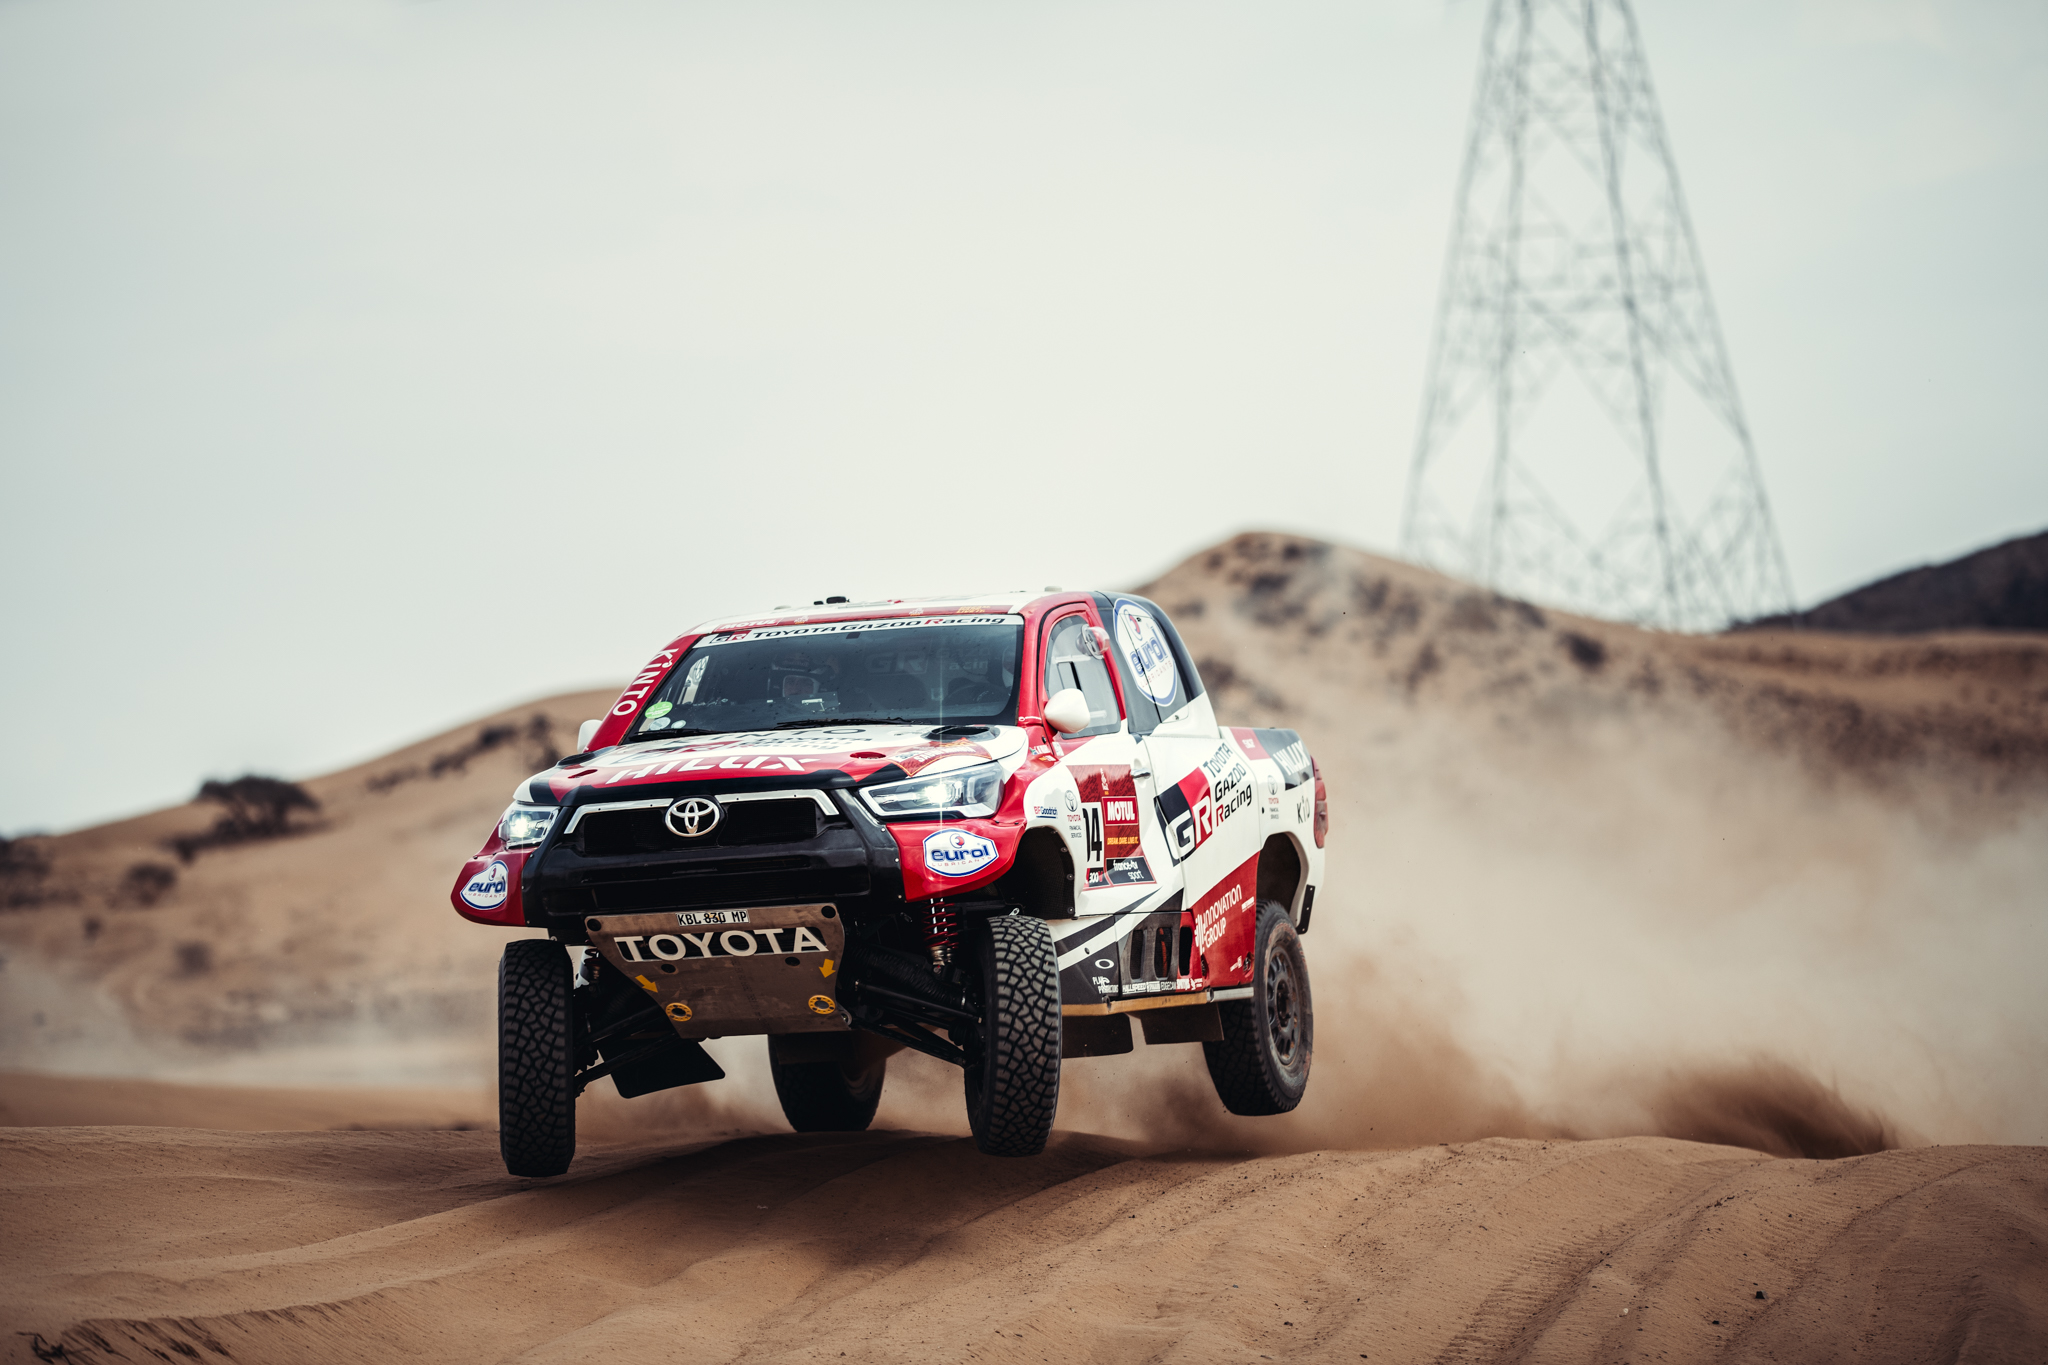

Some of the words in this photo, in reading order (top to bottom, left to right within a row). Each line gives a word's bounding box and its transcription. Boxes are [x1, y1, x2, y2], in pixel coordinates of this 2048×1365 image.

[719, 619, 778, 631] MOTUL
[752, 625, 838, 639] TOYOTA
[840, 620, 922, 636] GAZOO
[923, 616, 1006, 625] Racing
[1130, 626, 1168, 677] eurol
[605, 756, 821, 785] HILUX
[1202, 743, 1233, 778] TOYOTA
[1272, 740, 1311, 776] HILUX
[1214, 763, 1247, 803] GAZOO
[1033, 806, 1058, 816] BFGoodrich
[1106, 800, 1136, 821] MOTUL
[1216, 784, 1252, 828] Racing
[1165, 795, 1213, 861] GR
[931, 844, 990, 862] eurol
[932, 856, 992, 867] LUBRICANTS
[468, 875, 506, 893] eurol
[677, 913, 701, 926] KBL
[731, 910, 748, 923] MP
[1204, 916, 1227, 949] GROUP
[613, 926, 830, 962] TOYOTA
